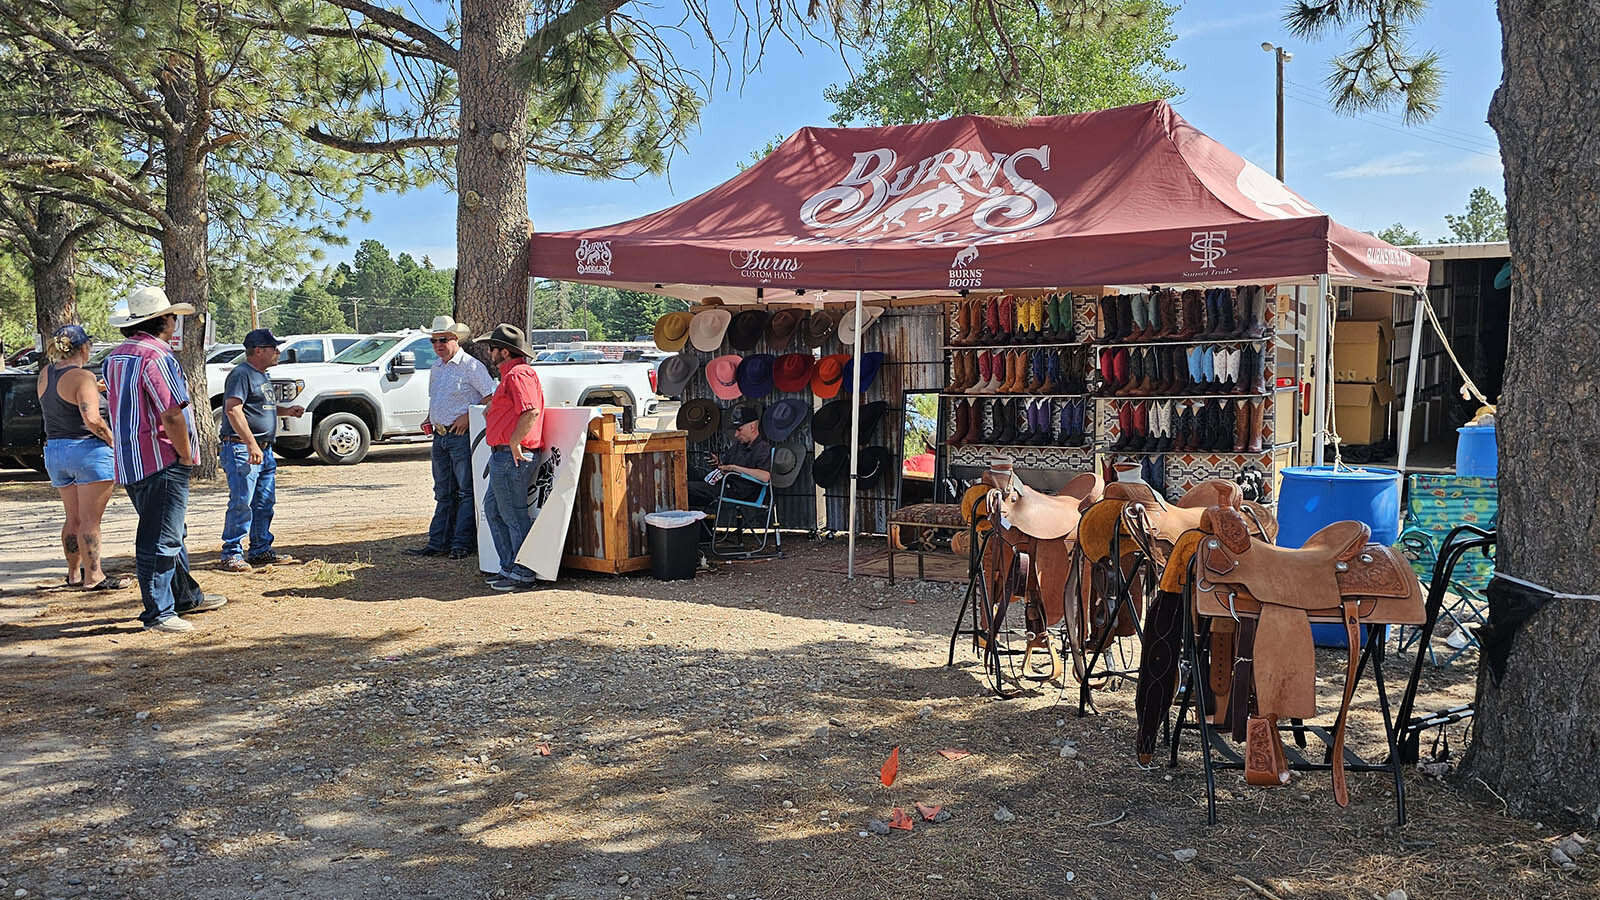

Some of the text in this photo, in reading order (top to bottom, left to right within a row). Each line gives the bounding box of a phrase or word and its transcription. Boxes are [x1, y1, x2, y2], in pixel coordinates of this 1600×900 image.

[729, 248, 804, 272] Burns
[741, 269, 793, 280] CUSTOM HATS
[949, 268, 983, 279] BURNS
[949, 278, 982, 288] BOOTS
